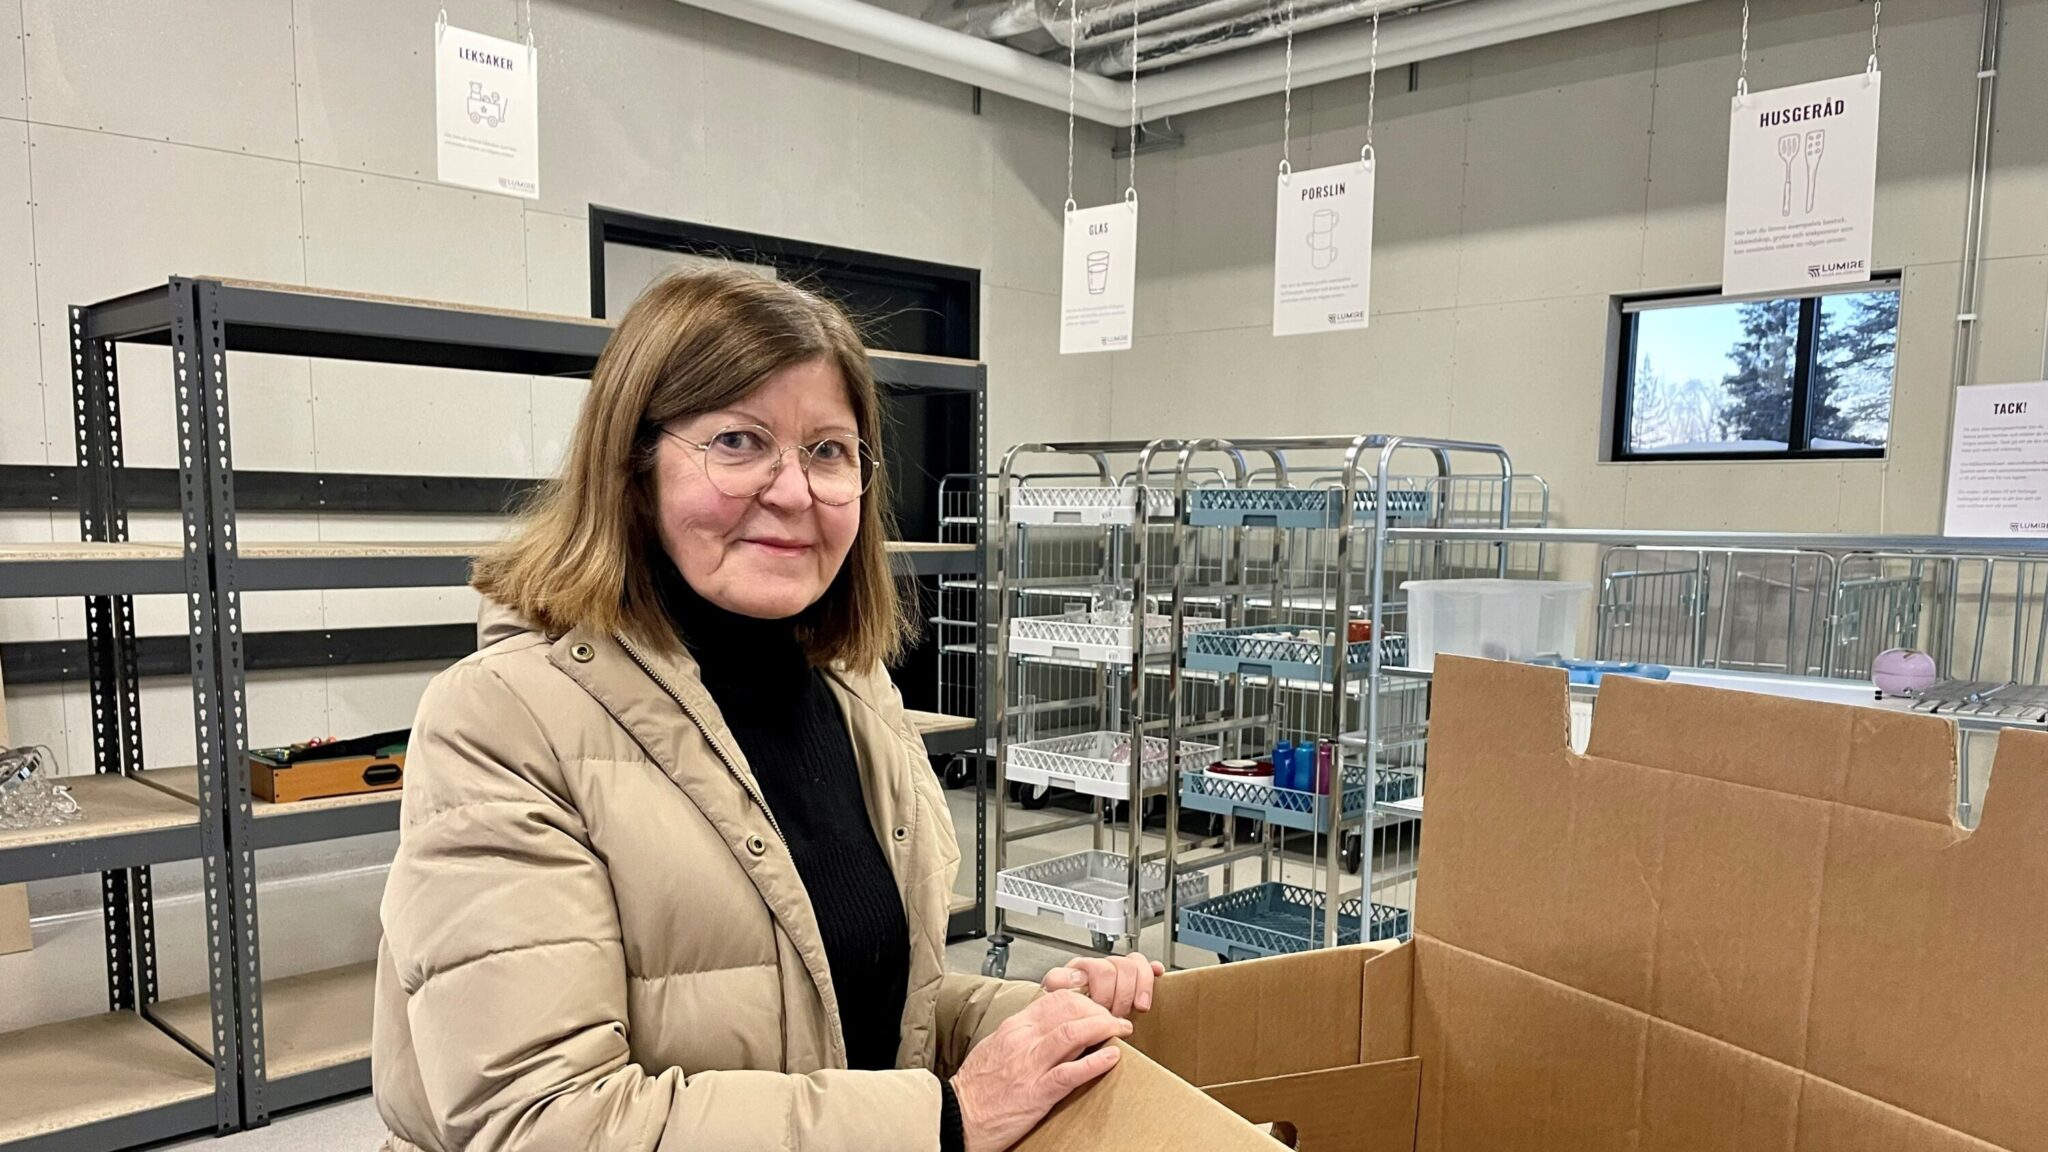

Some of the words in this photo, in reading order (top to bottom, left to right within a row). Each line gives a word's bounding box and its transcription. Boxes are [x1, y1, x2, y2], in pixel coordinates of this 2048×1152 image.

[459, 47, 513, 71] LEKSAKER
[1760, 97, 1845, 128] HUSGERÅD
[1301, 182, 1346, 201] PORSLIN
[1089, 222, 1109, 236] GLAS
[1822, 260, 1864, 272] LUMIRE
[1993, 402, 2027, 415] TACK!
